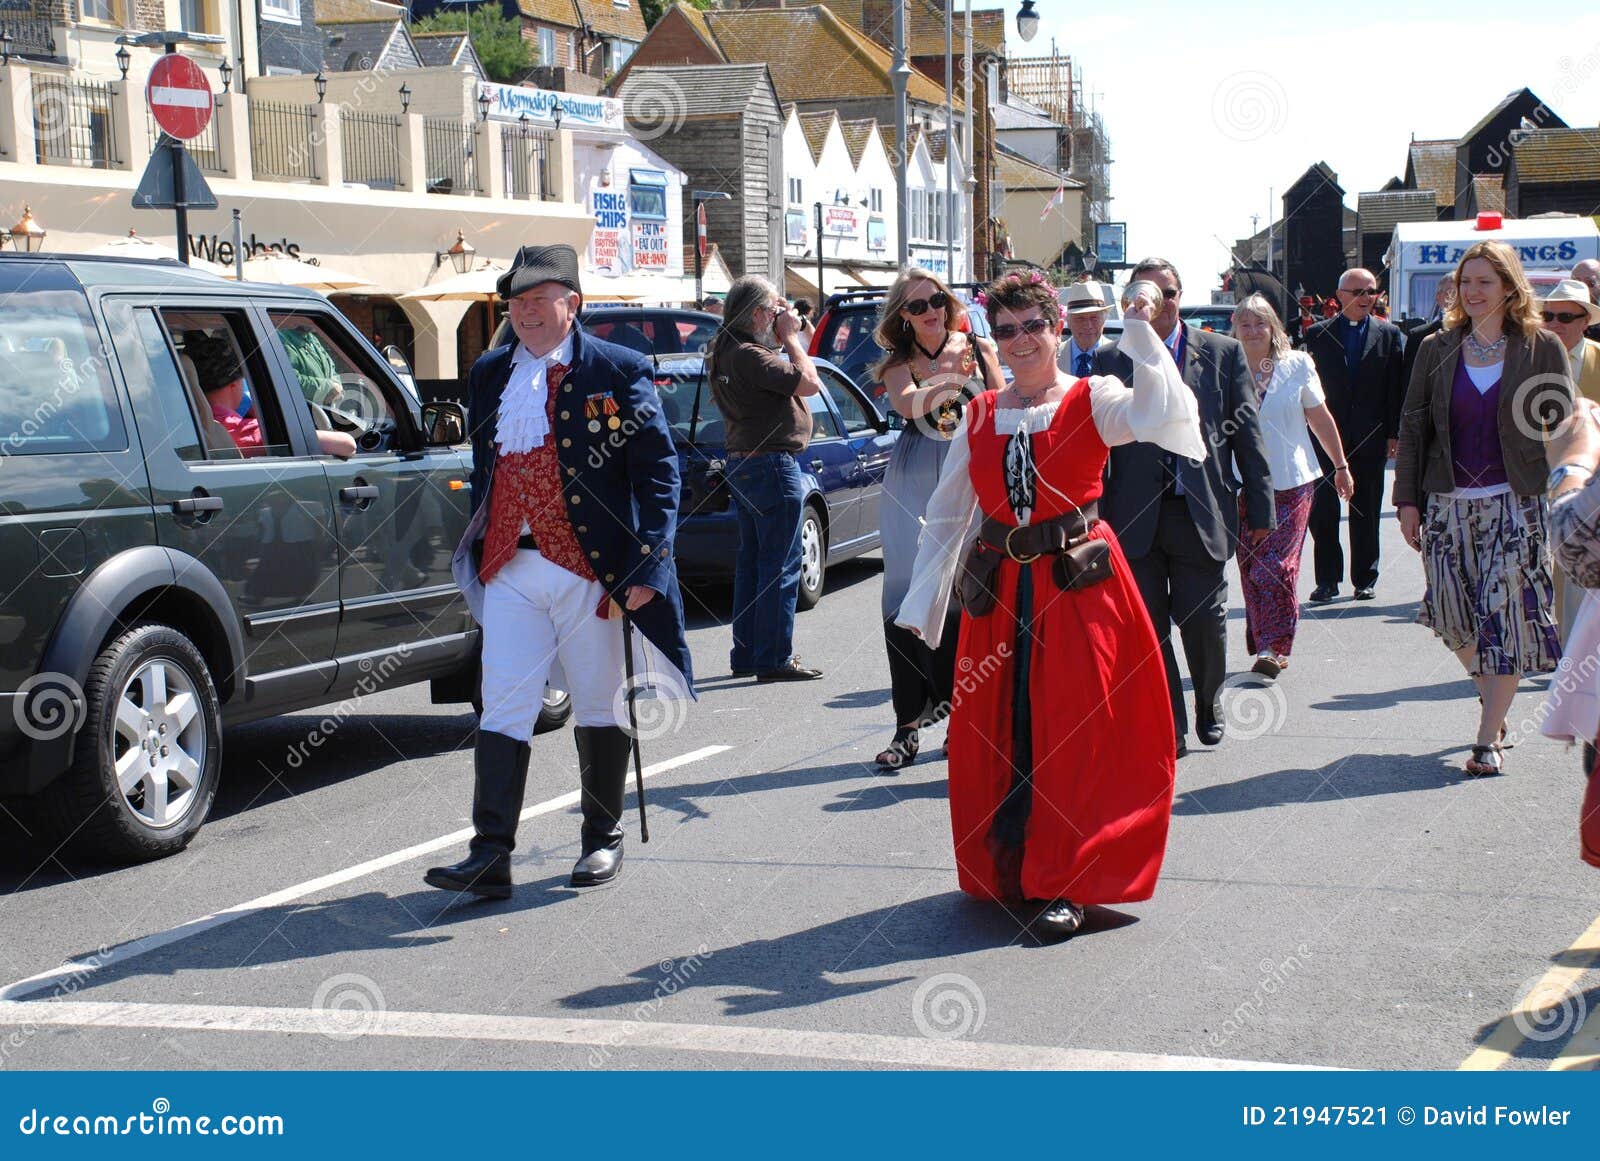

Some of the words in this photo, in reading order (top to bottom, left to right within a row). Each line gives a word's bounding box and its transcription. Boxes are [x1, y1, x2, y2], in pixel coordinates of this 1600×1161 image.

[498, 87, 547, 113] Mermaid
[593, 192, 616, 210] FISH
[618, 194, 626, 210] &
[595, 211, 626, 228] CHIPS
[642, 224, 651, 235] EAT
[653, 224, 660, 235] IN
[639, 238, 649, 250] EAT
[650, 238, 664, 250] OUT
[1418, 240, 1578, 264] HANGS
